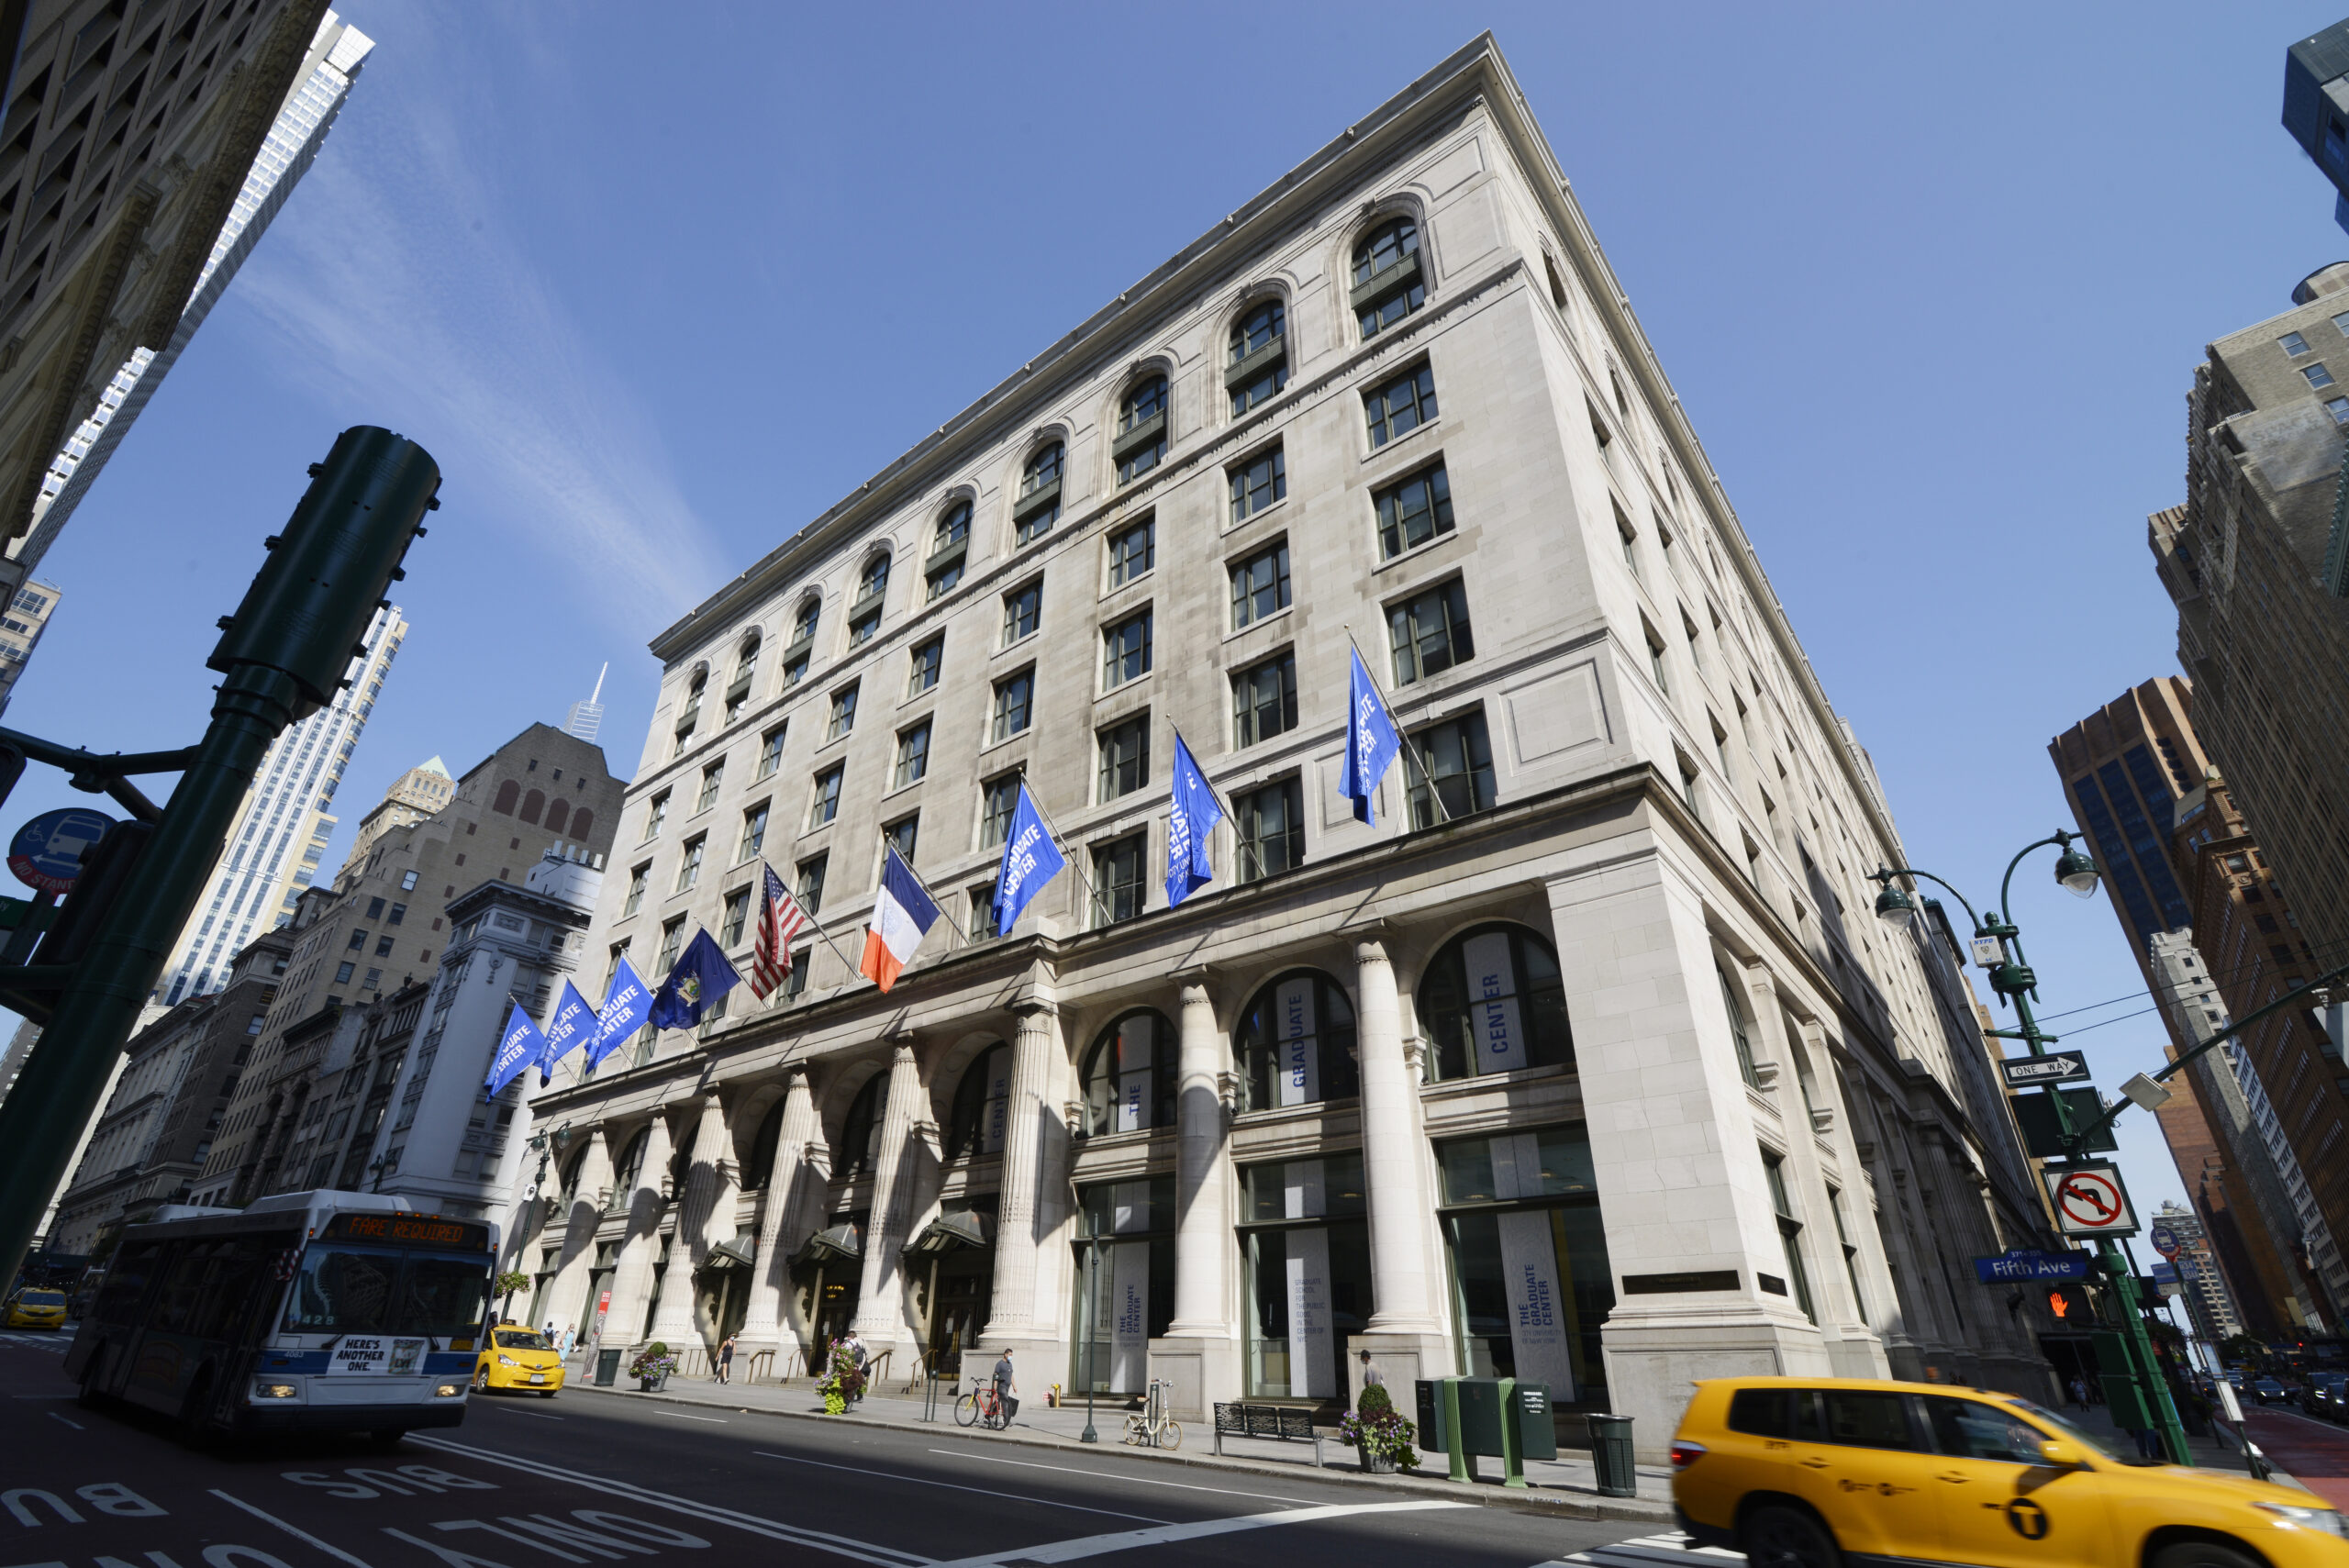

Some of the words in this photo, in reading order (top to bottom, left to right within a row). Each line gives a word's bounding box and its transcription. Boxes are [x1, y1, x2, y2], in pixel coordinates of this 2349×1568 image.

[1008, 824, 1041, 873] ADUATE
[14, 861, 32, 876] NO
[1483, 974, 1508, 1054] CENTER
[1289, 994, 1307, 1088] GRADUATE
[2016, 1065, 2039, 1075] ONE
[2046, 1062, 2069, 1072] WAY
[992, 1079, 1006, 1139] CENTER
[1129, 1084, 1141, 1117] THE
[349, 1217, 389, 1237] FARE
[393, 1220, 463, 1242] REQUIRED
[1992, 1261, 2032, 1276] Fifth
[2038, 1261, 2071, 1274] Ave
[1525, 1263, 1542, 1327] GRADUATE
[1538, 1280, 1553, 1326] CENTER
[1519, 1304, 1531, 1327] THE
[336, 1351, 384, 1362] ANOTHER
[345, 1340, 381, 1350] HERE'S
[280, 1465, 502, 1499] BUS
